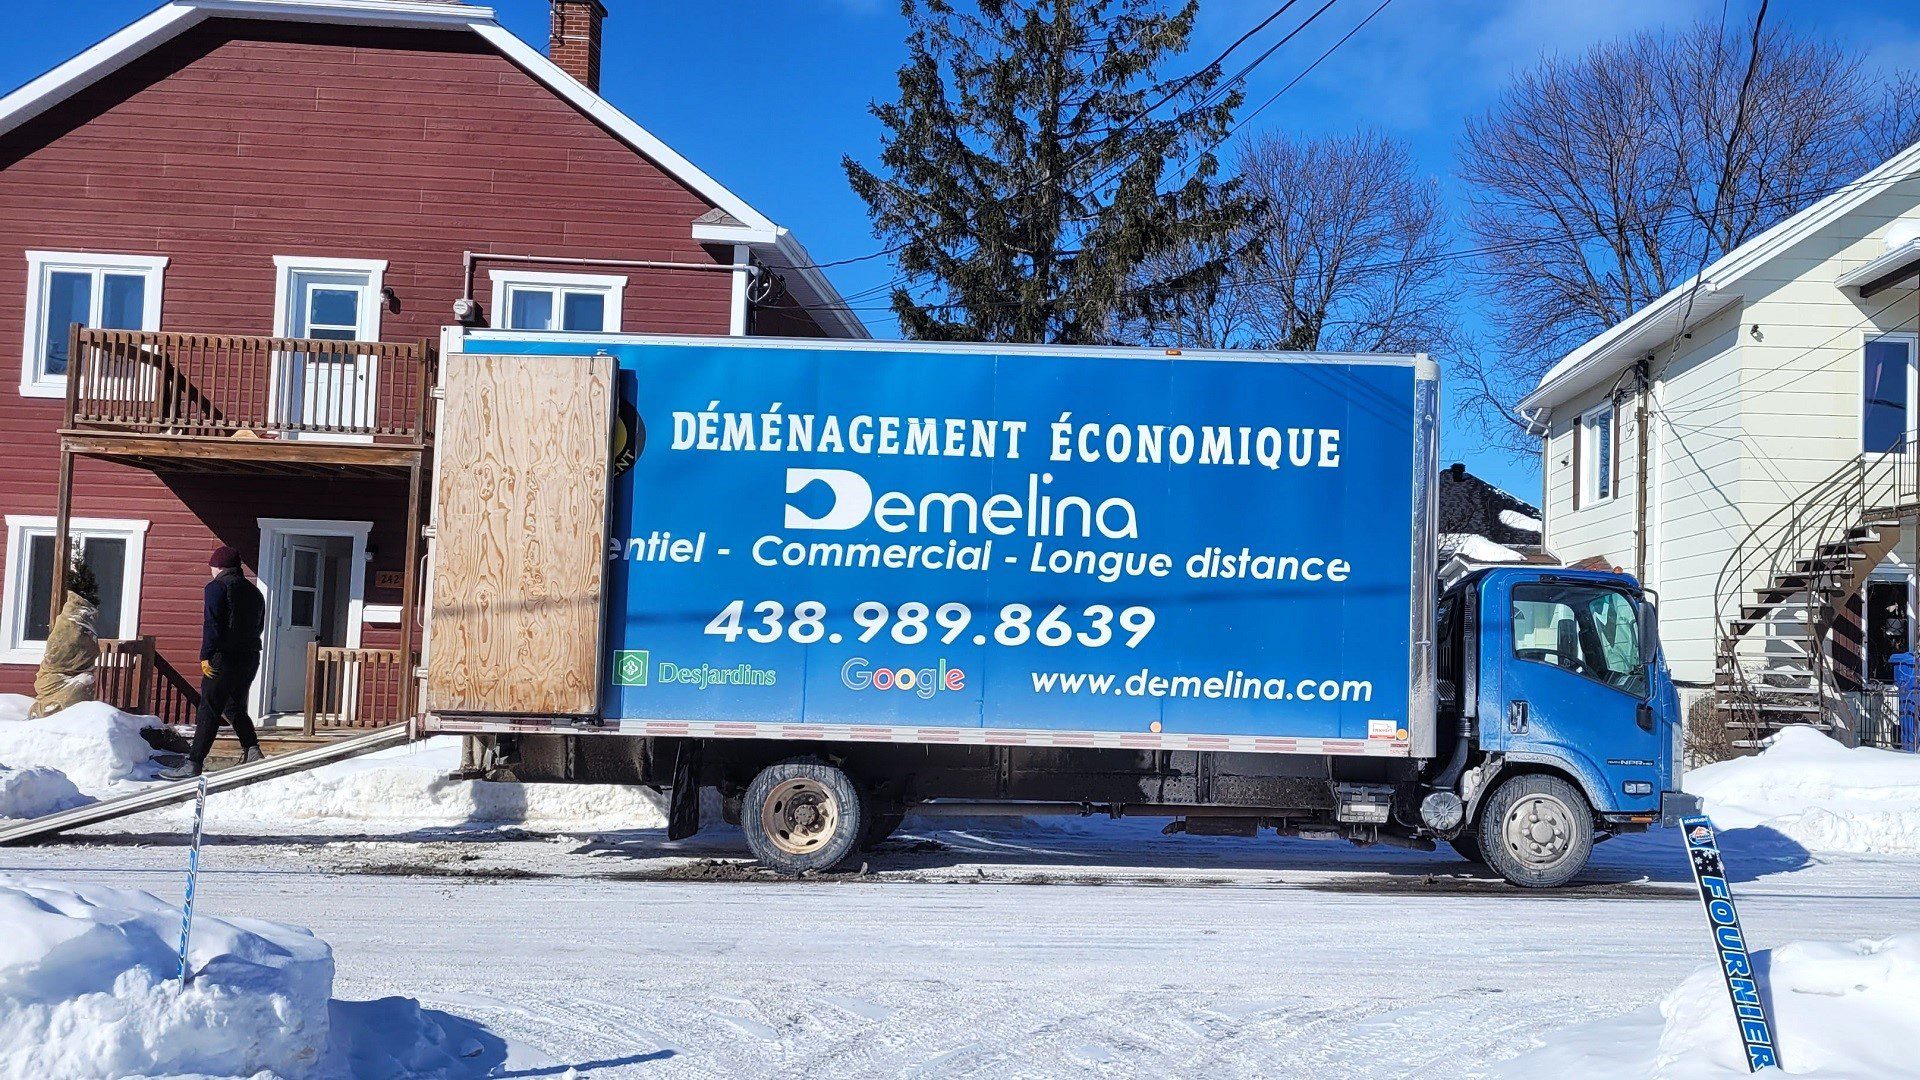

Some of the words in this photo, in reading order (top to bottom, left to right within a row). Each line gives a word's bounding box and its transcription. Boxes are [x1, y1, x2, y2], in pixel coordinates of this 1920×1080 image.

[671, 400, 1027, 459] DÉMÉNAGEMENT
[1049, 411, 1341, 470] ÉCONOMIQUE
[784, 467, 1138, 539] Demelina
[752, 535, 992, 571] Commercial
[1030, 541, 1173, 583] Longue
[1185, 547, 1351, 582] distance
[703, 600, 1156, 649] 438.989.8639
[658, 662, 776, 690] Desjardins
[840, 657, 966, 700] Google
[1031, 668, 1373, 702] www.demelina.com
[1701, 875, 1777, 1072] FOURNIER
